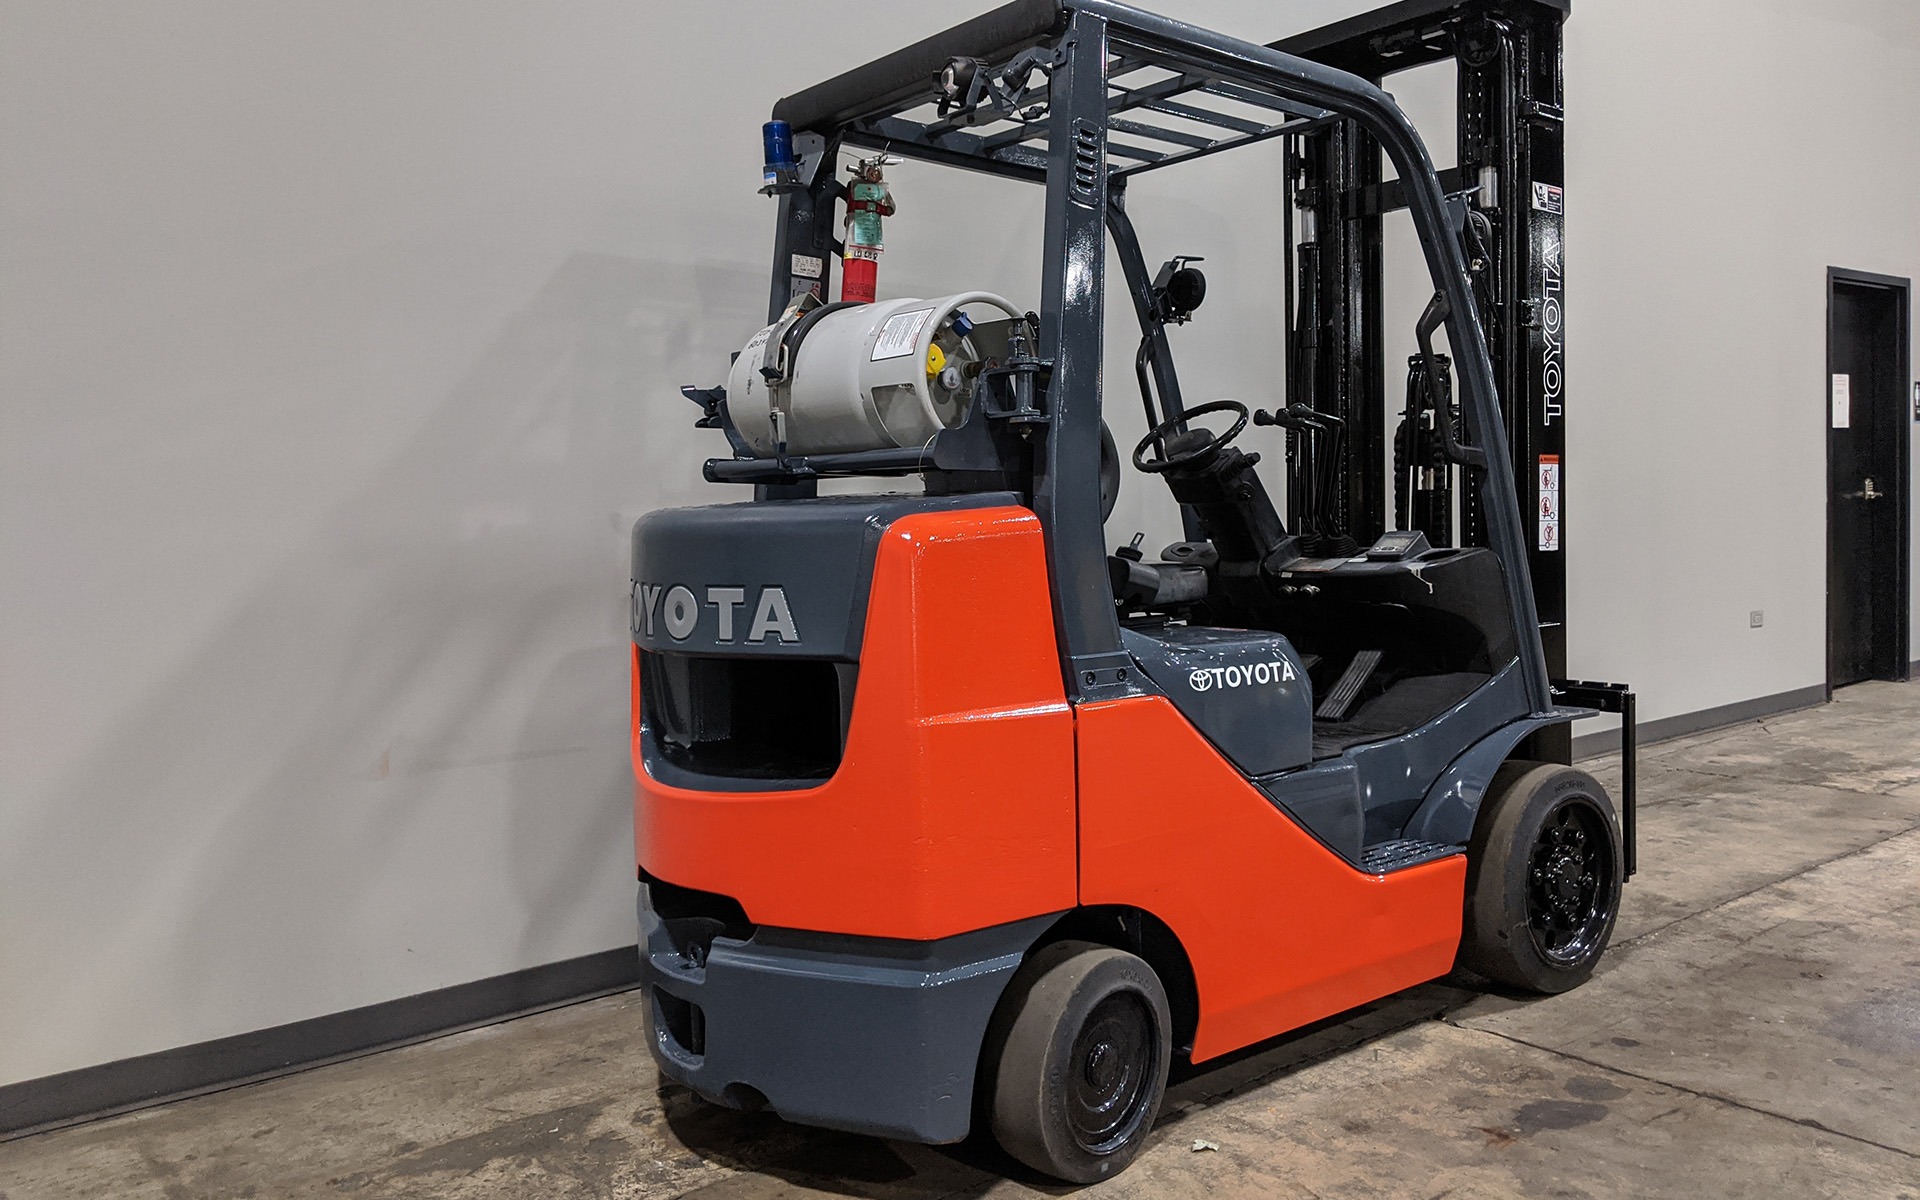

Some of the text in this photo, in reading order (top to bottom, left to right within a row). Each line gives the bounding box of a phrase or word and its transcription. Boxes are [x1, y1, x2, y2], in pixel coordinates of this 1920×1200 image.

[1543, 241, 1562, 426] TOYOTA
[631, 582, 799, 642] OYOTA
[1211, 661, 1296, 689] TOYOTA
